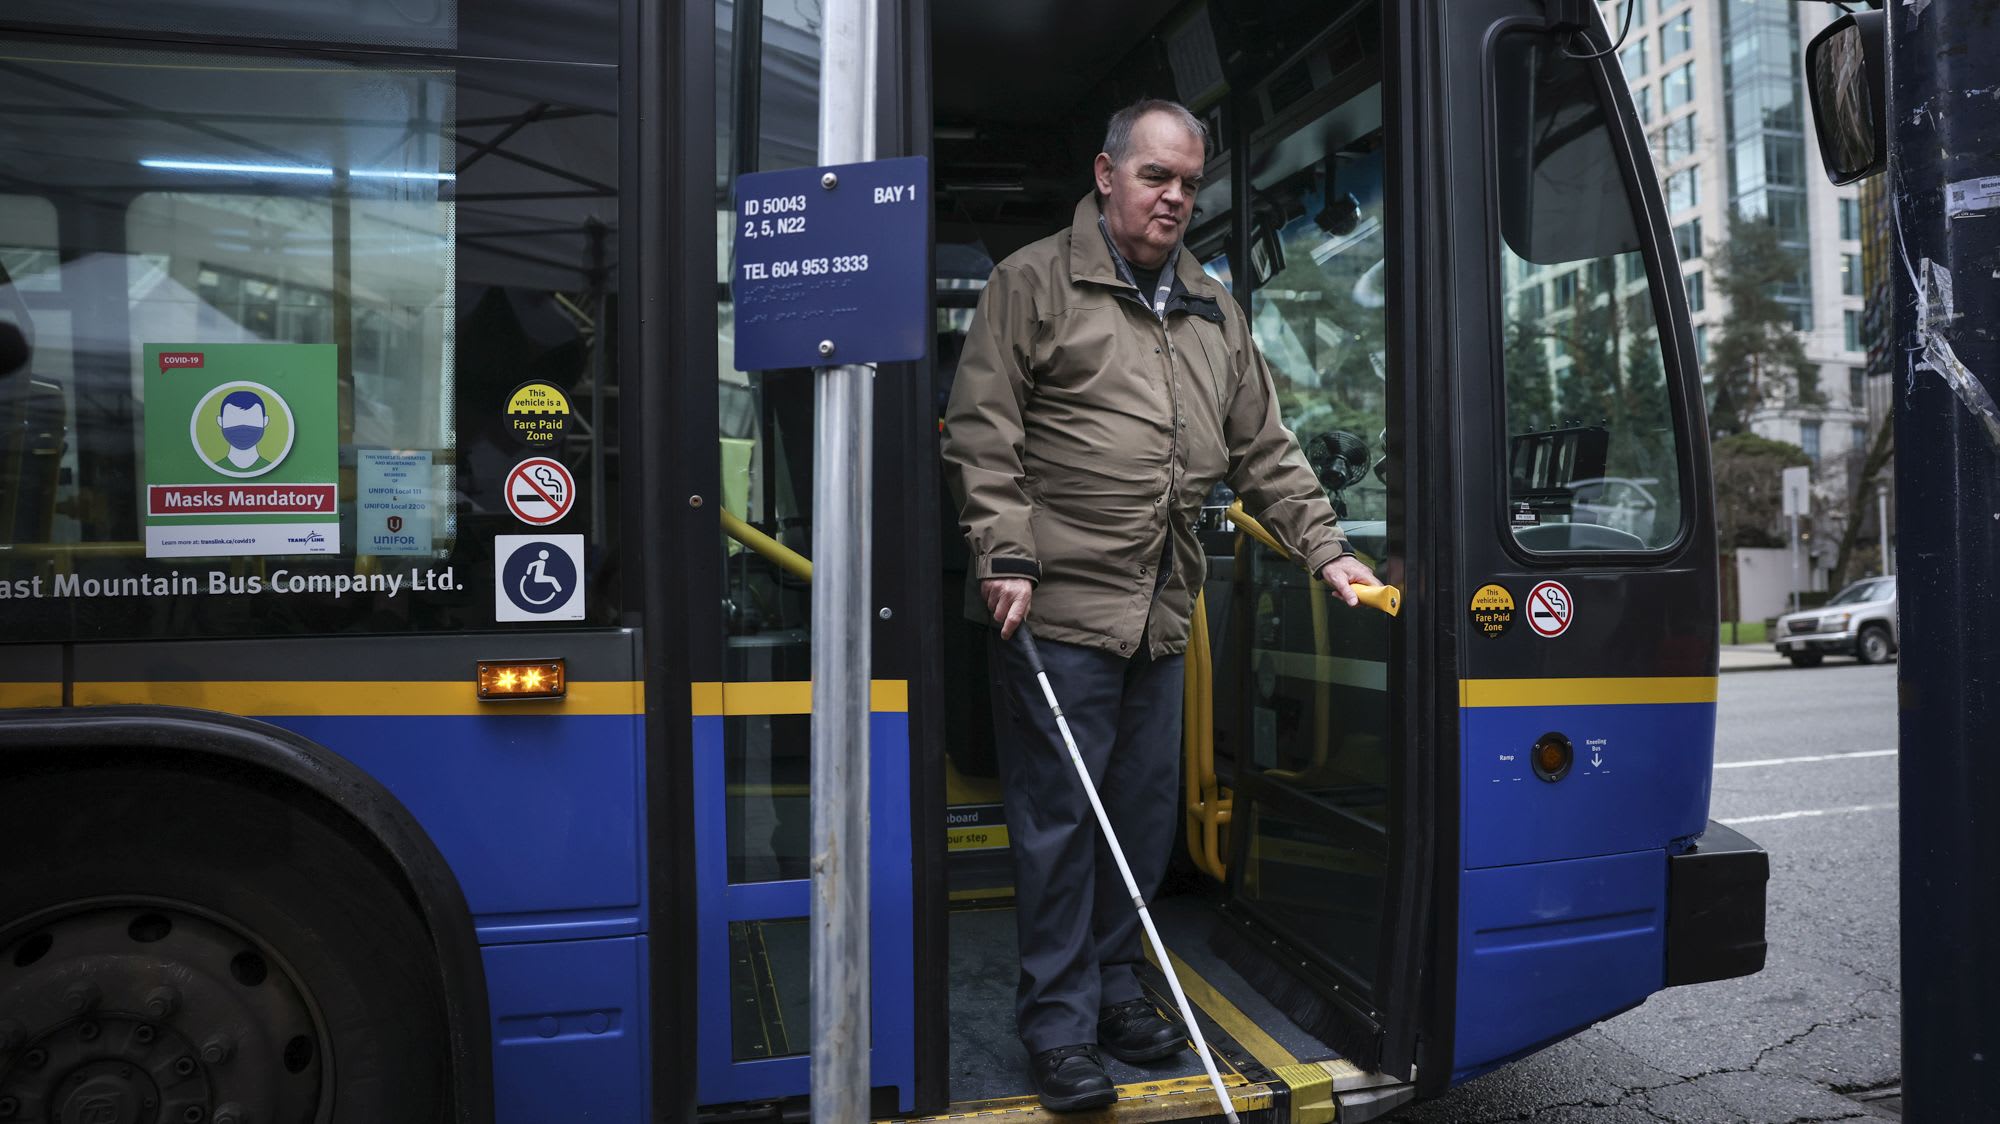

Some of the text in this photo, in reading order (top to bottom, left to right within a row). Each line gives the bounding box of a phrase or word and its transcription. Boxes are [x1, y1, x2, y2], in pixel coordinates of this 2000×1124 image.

[874, 184, 916, 204] BAY 1
[744, 195, 806, 216] ID 50043
[744, 216, 806, 240] 2, 5, N22
[743, 254, 869, 280] TEL 604 953 3333
[528, 389, 546, 397] This
[513, 419, 563, 430] Fare Paid
[526, 430, 553, 440] Zone
[164, 490, 325, 510] Masks Mandatory
[54, 570, 198, 598] Mountain
[208, 571, 262, 595] Bus
[271, 569, 404, 598] Company
[412, 566, 464, 591] Ltd.
[1475, 613, 1510, 622] Fare Paid
[1484, 622, 1503, 631] Zone
[966, 833, 988, 844] step
